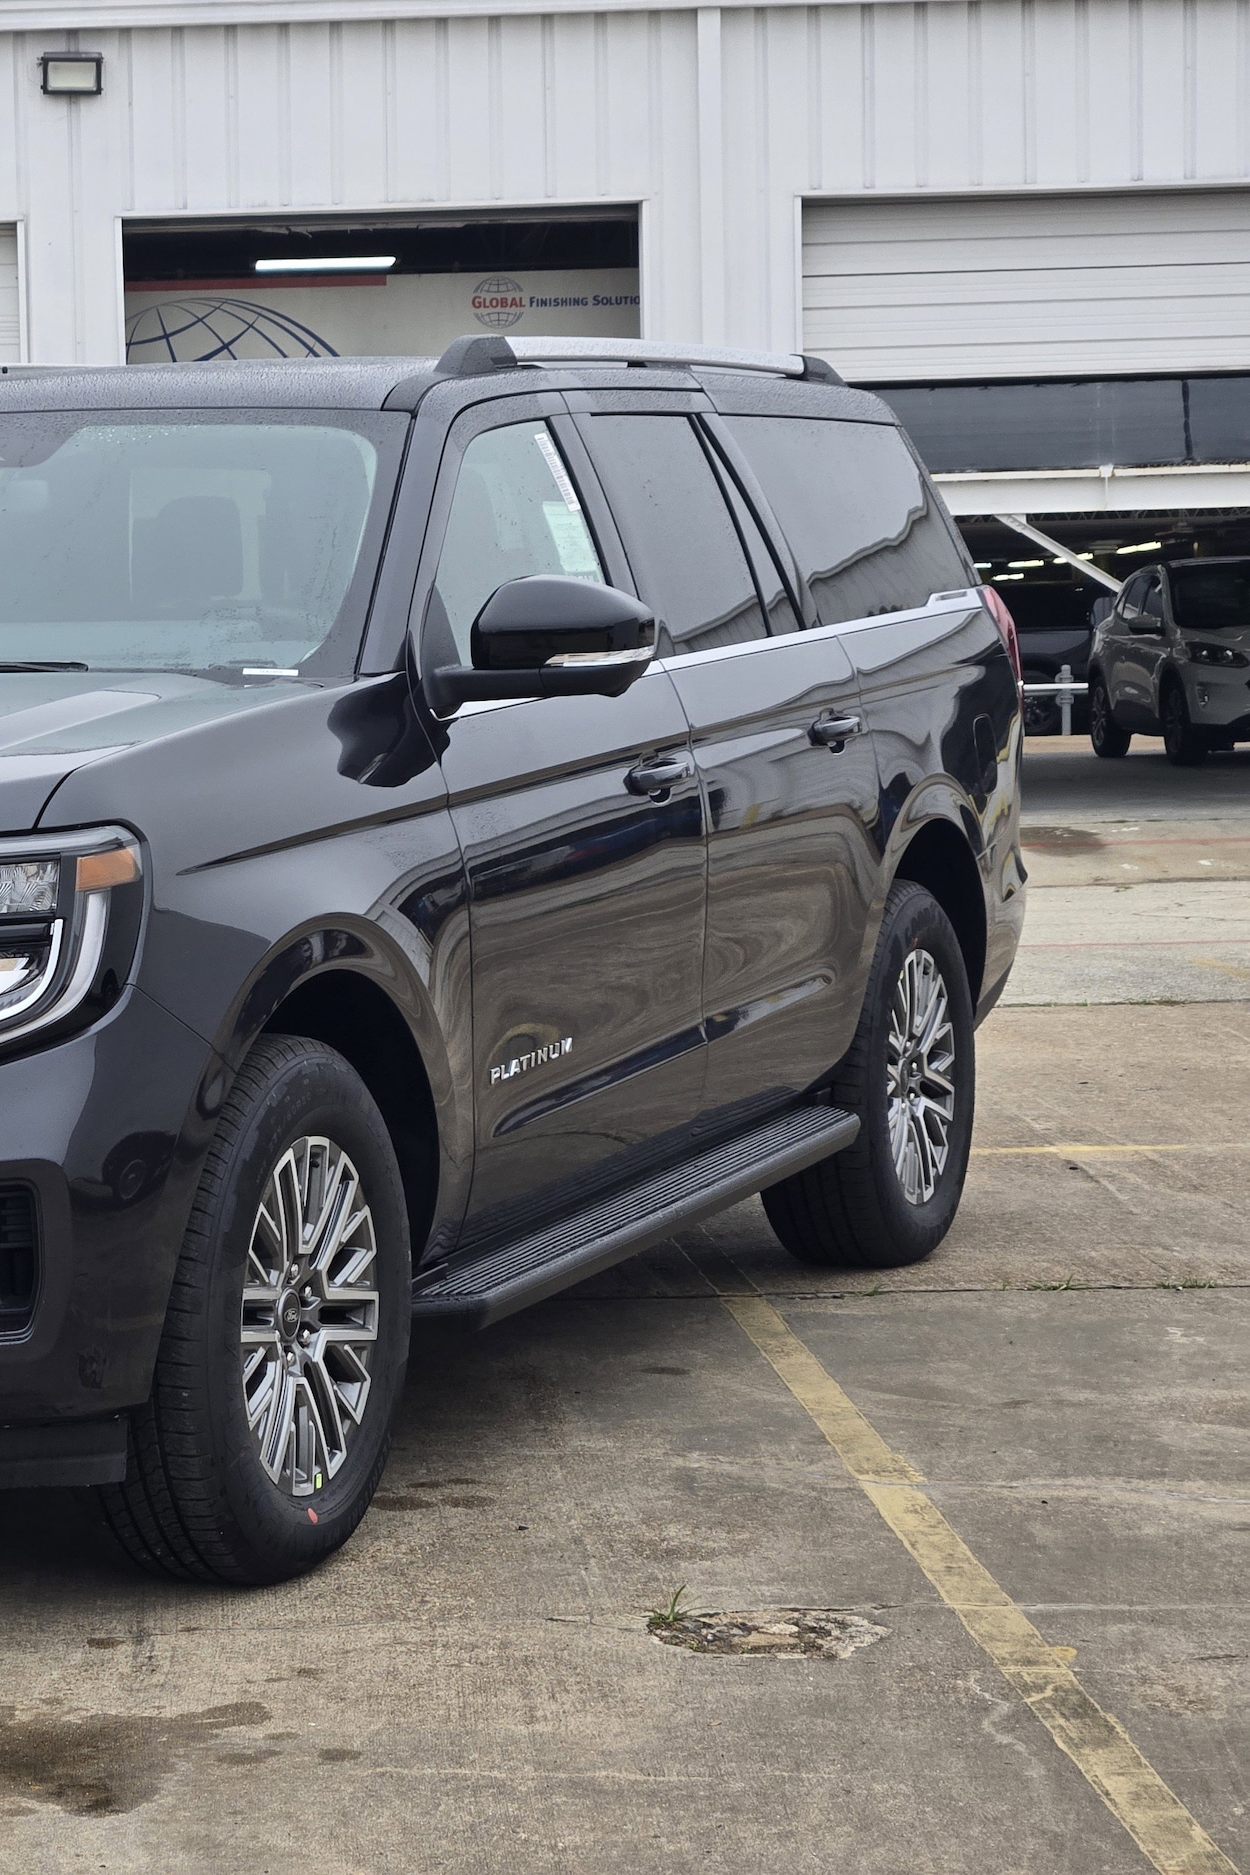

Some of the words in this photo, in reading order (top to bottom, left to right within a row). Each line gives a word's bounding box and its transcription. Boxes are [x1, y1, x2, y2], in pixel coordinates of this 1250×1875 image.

[471, 296, 526, 309] GLOBAL
[529, 296, 589, 308] FINISHING
[490, 1037, 573, 1085] PLATINUM
